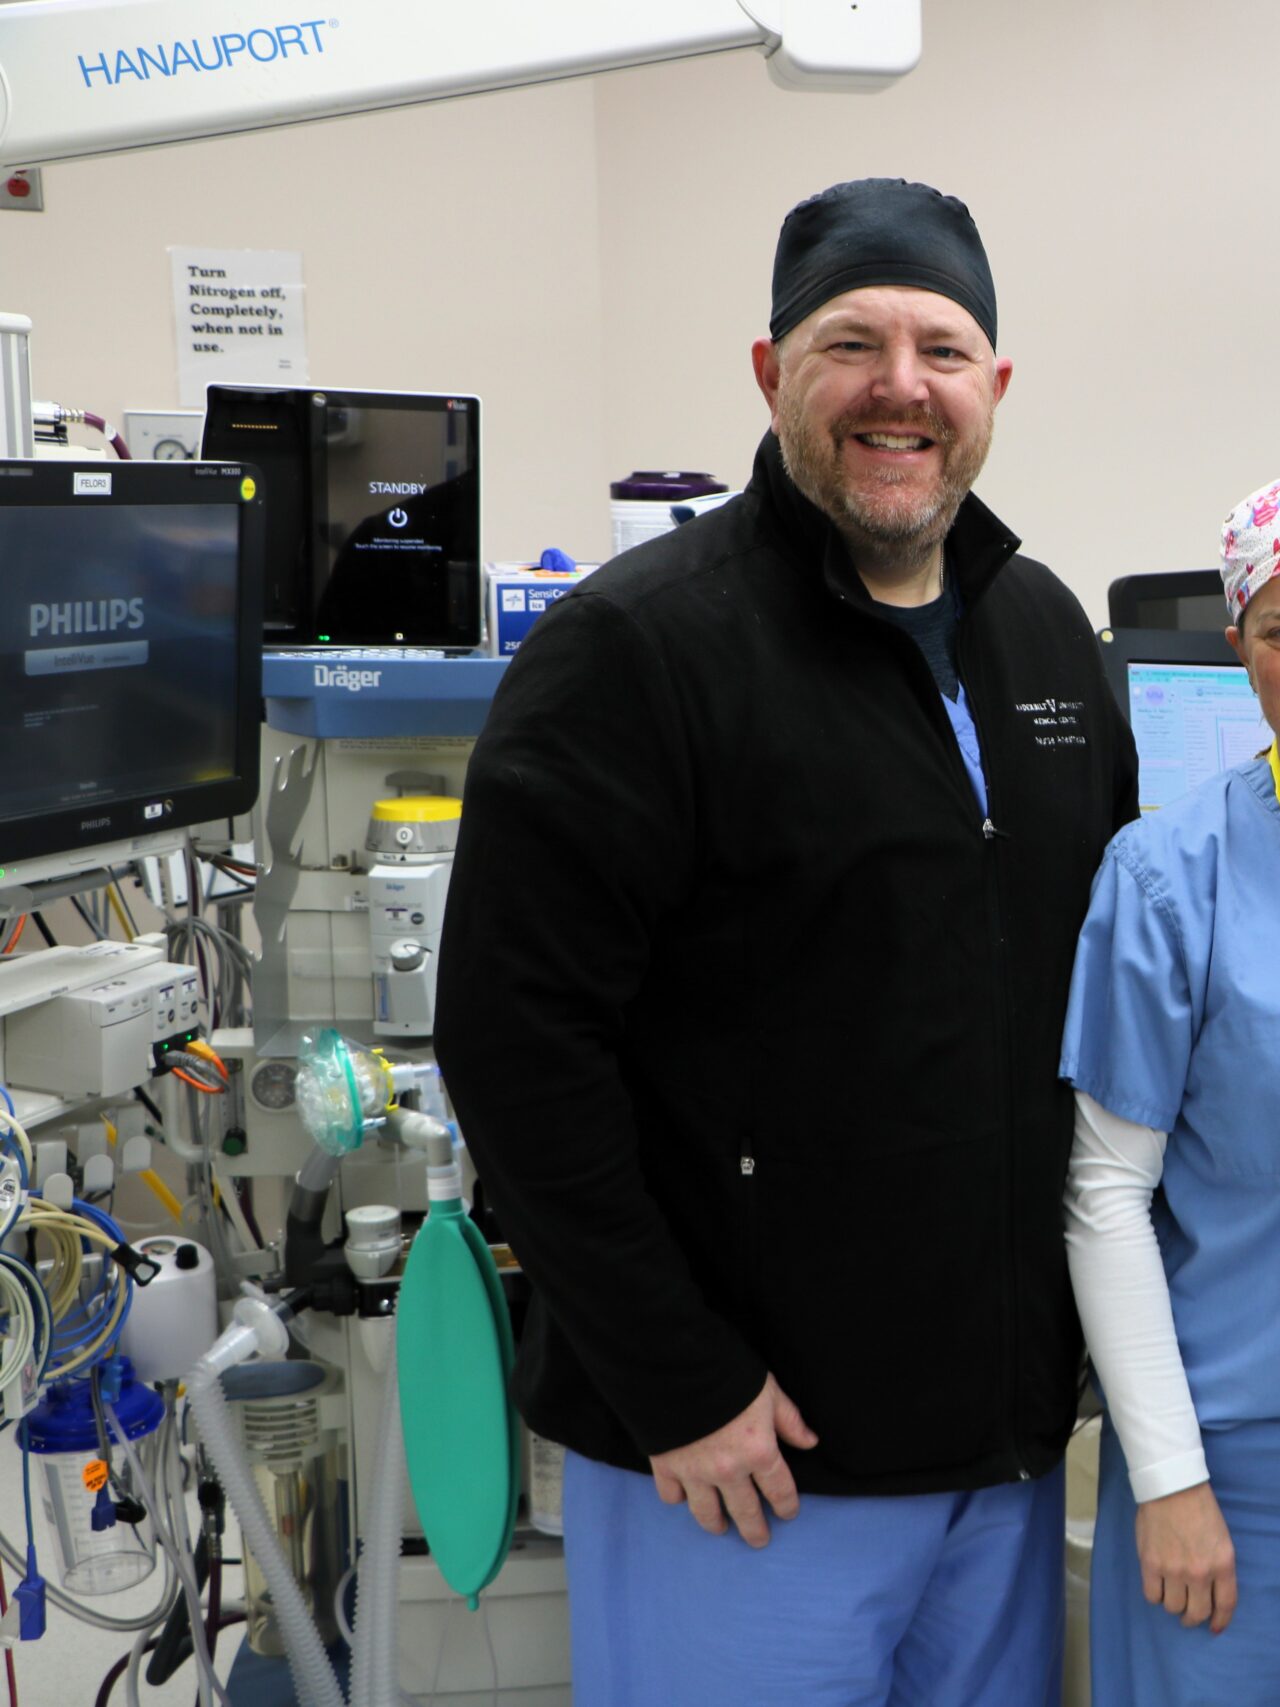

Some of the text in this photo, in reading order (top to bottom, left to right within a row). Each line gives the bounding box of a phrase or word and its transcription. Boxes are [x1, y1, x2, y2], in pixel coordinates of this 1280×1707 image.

[188, 266, 226, 278] Turn
[189, 284, 286, 301] Nitrogen off,
[190, 303, 284, 320] Completely,
[191, 323, 284, 336] when not in
[193, 343, 224, 353] use.
[369, 481, 427, 495] STANDBY
[528, 588, 567, 599] SensiCa
[30, 597, 145, 637] PHILIPS
[314, 665, 382, 691] Dräger
[81, 817, 111, 831] PHILIPS
